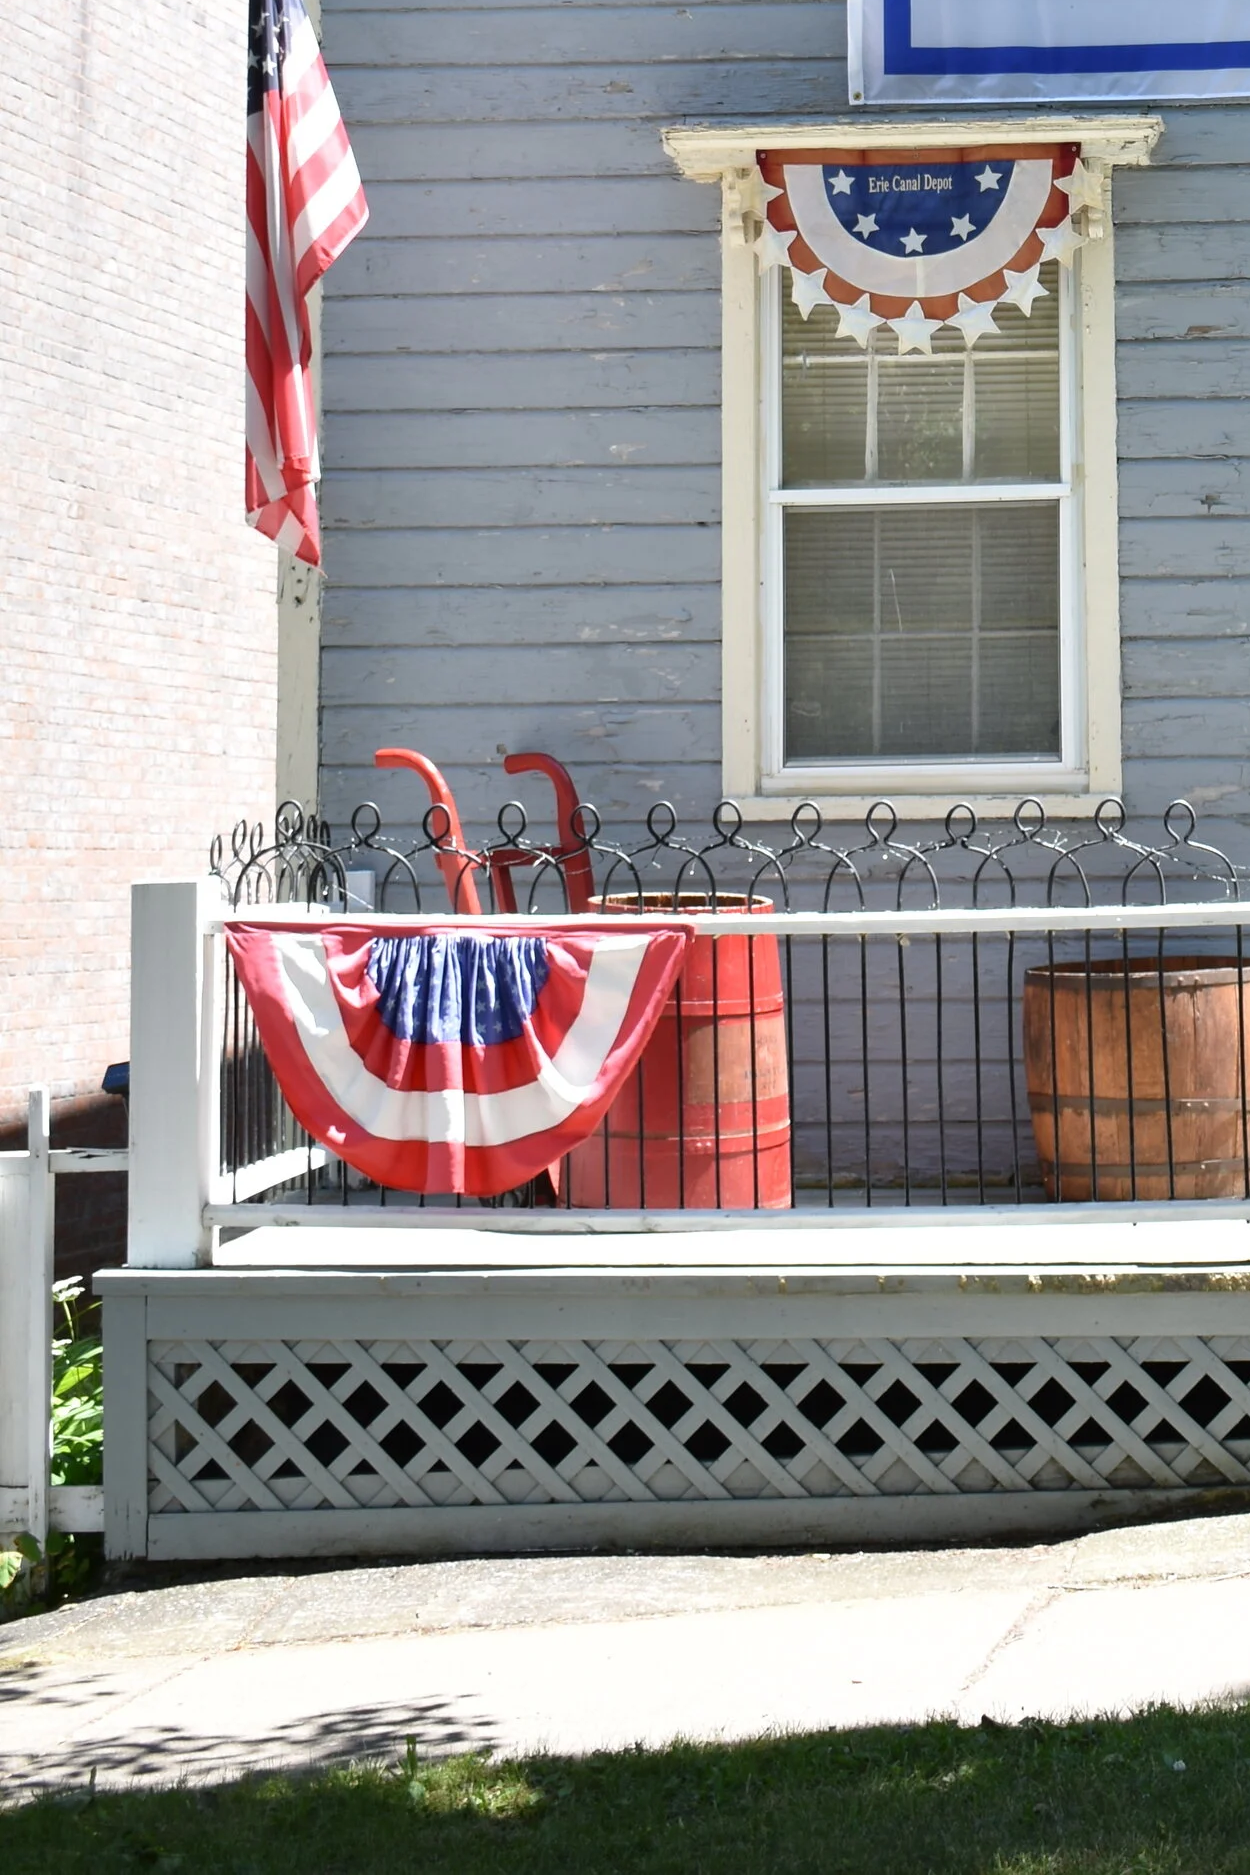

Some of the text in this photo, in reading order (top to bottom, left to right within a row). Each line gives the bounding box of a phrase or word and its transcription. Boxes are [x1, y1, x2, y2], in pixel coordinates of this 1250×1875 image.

[868, 173, 952, 193] Erie Canal Depot
